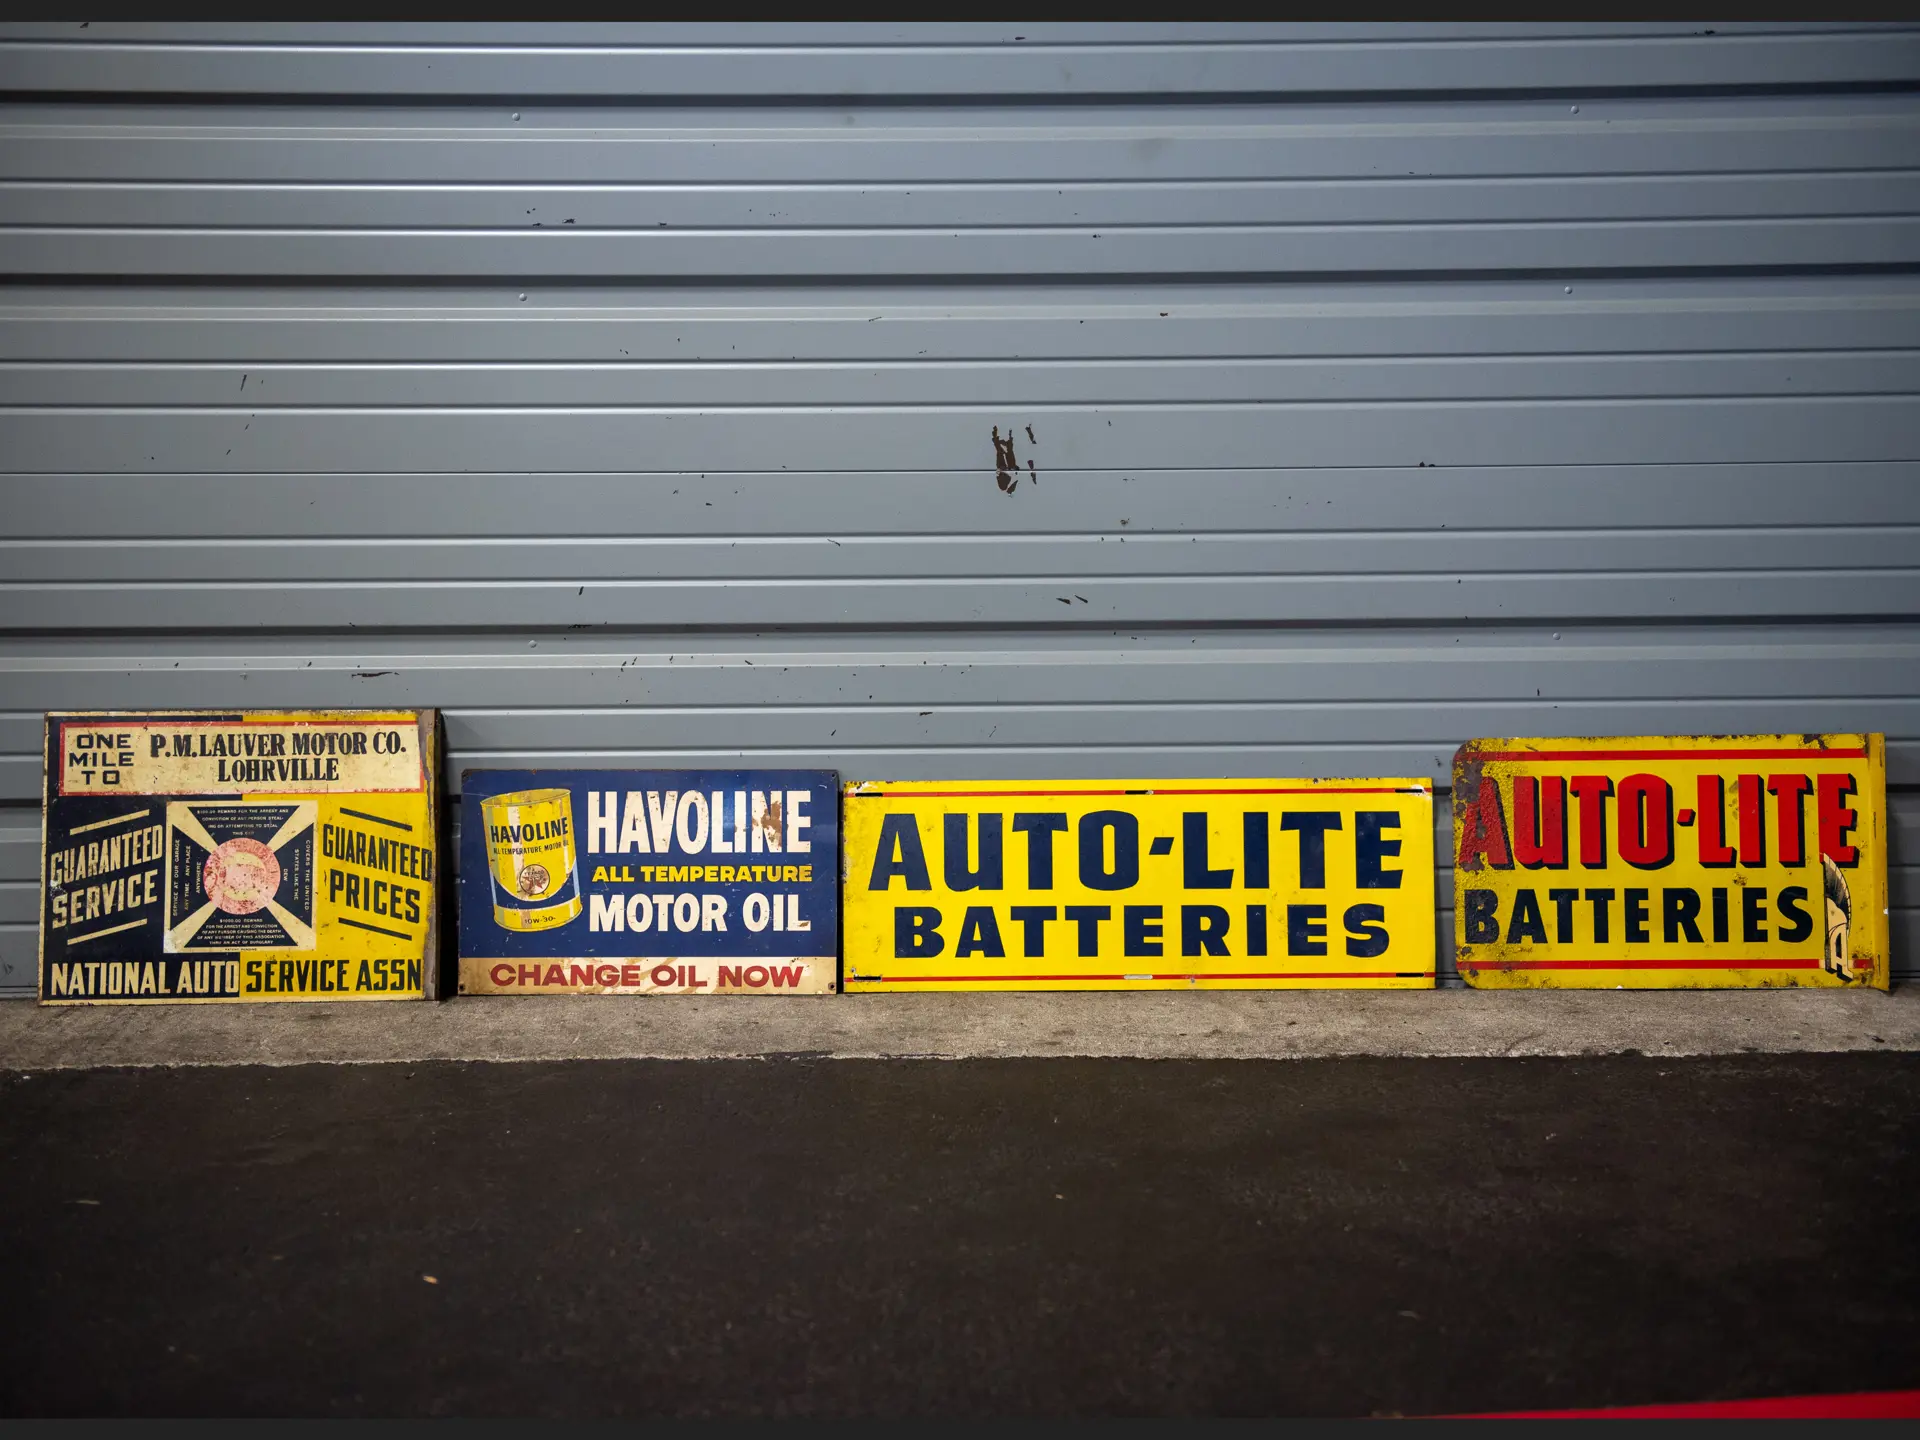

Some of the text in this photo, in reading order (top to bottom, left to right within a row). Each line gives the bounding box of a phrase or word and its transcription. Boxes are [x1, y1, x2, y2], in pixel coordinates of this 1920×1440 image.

[69, 752, 134, 768] MILE
[76, 733, 132, 749] ONE
[291, 732, 368, 755] MOTOR
[372, 731, 407, 755] CO.
[81, 770, 120, 785] TO
[217, 758, 340, 782] LOHRVILLE
[490, 817, 568, 843] HAVOLINE
[588, 790, 812, 854] HAVOLINE
[1458, 773, 1860, 871] AUTO-LITE
[50, 824, 164, 888] GUARANTEED
[322, 822, 433, 882] GUARANTEED
[502, 846, 542, 855] TEMPERATURE
[544, 842, 561, 850] MOTOR
[868, 809, 1404, 892] AUTO-LITE
[592, 864, 813, 883] ALL TEMPERATURE
[52, 868, 159, 929] SERVICE
[329, 869, 421, 924] PRICES
[589, 892, 811, 933] MOTOR OIL
[1463, 886, 1814, 944] BATTERIES
[894, 903, 1390, 958] BATTERIES
[51, 958, 422, 997] NATIONAL AUTO SERVICE ASSN
[490, 963, 804, 988] CHANGE OIL NOW
